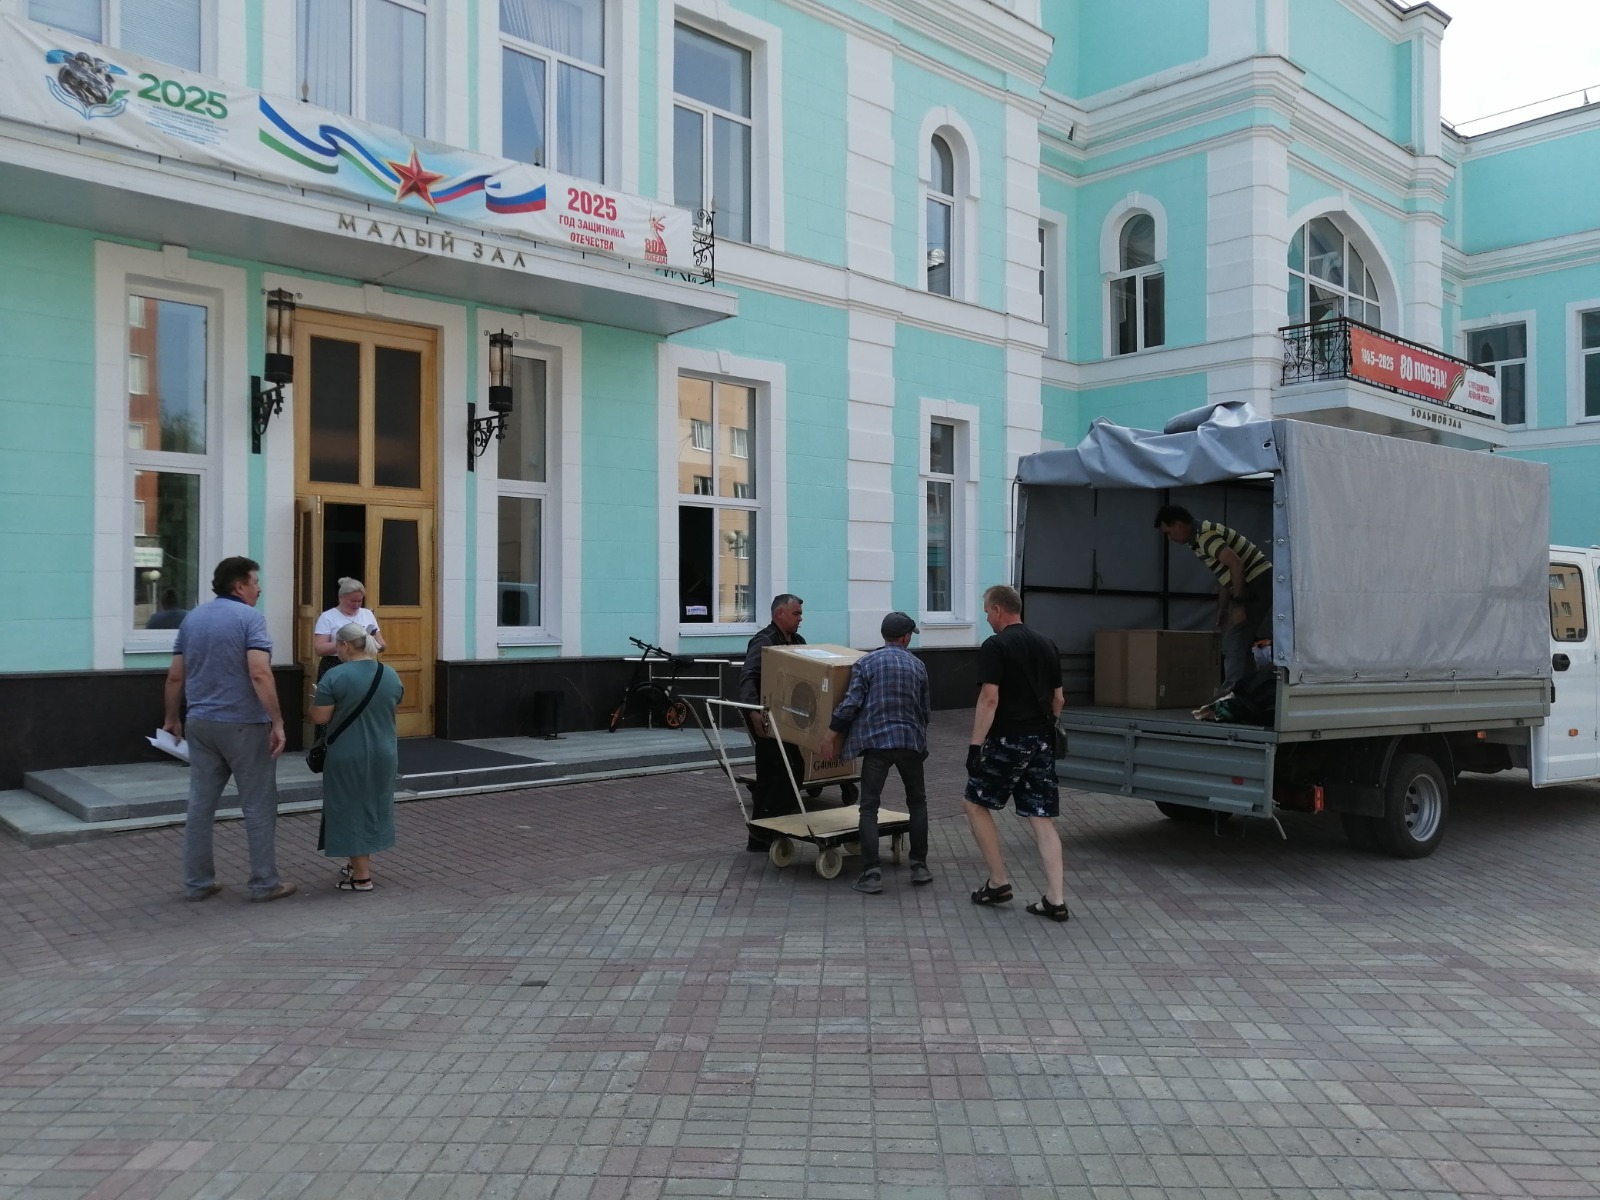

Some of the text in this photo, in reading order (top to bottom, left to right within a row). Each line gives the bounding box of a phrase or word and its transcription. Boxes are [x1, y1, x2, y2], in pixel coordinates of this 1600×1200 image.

[137, 73, 228, 119] 2025
[567, 187, 617, 221] 2025
[338, 213, 526, 268] МАЛЫЙ ЗАЛ
[559, 215, 625, 239] ГОД ЗАЩИТНИКА
[570, 231, 614, 251] ОТЕЧЕСТВА
[1400, 354, 1413, 381] 80
[1414, 361, 1448, 390] ПОБЕДА!
[1411, 407, 1462, 429] БОЛЬШОЙ ЗАЛ
